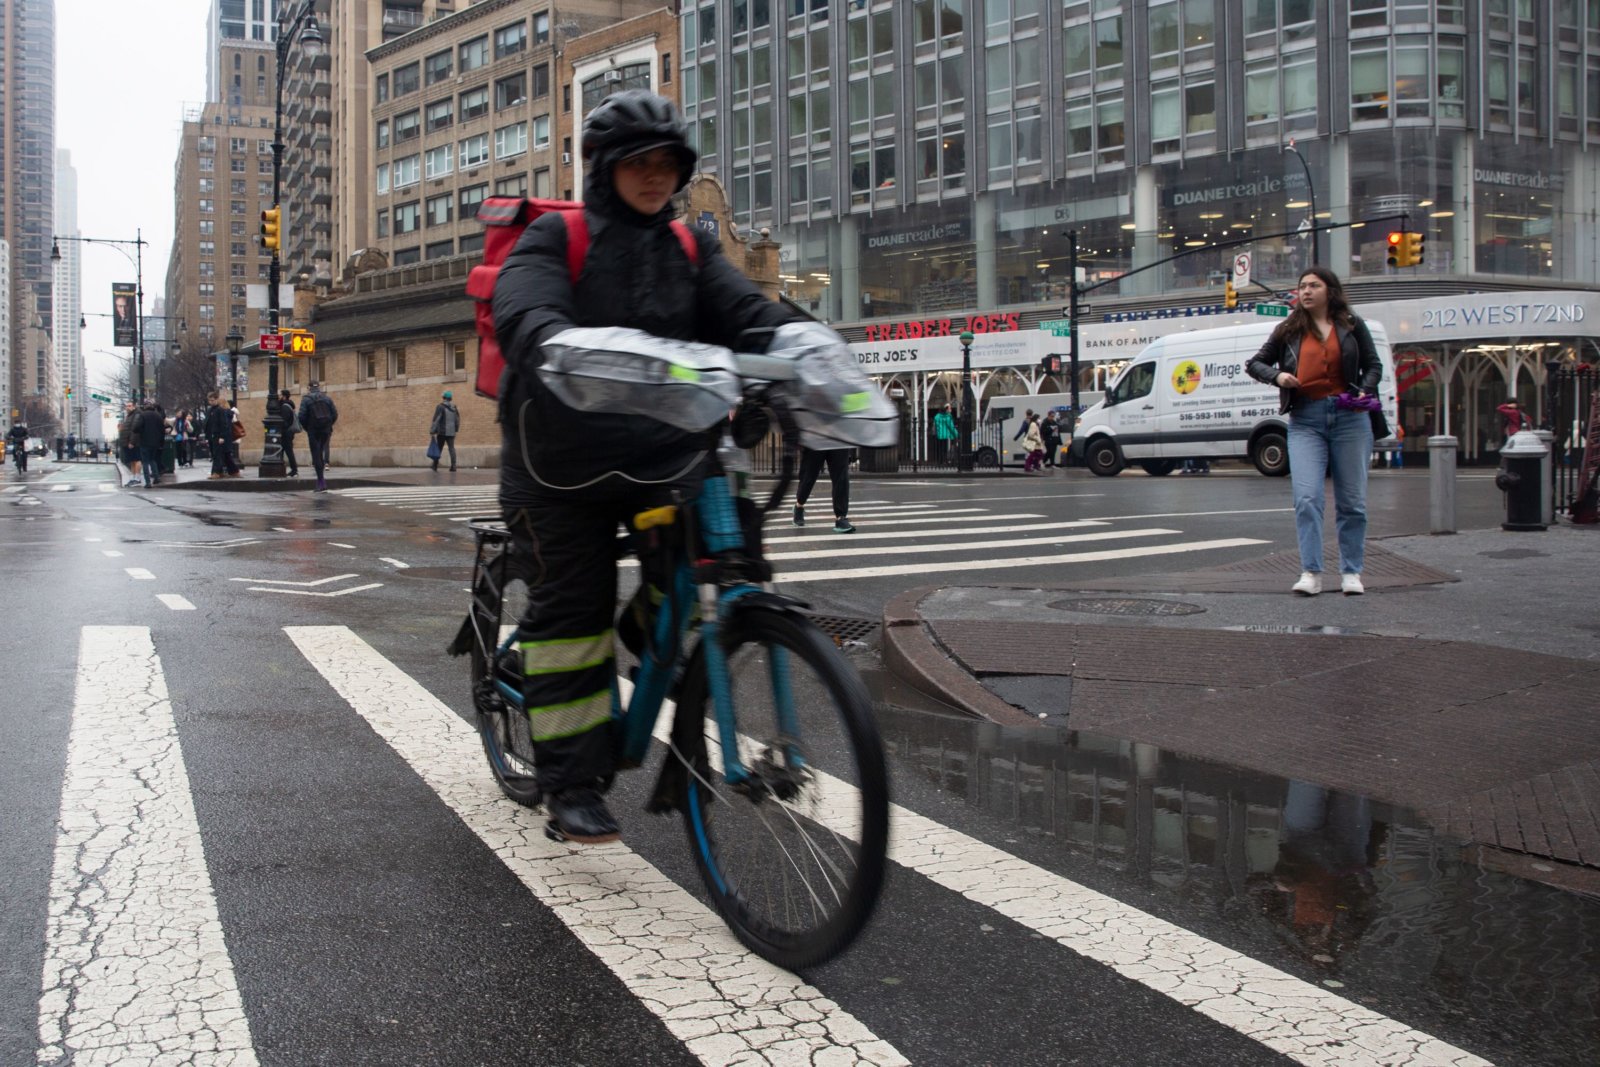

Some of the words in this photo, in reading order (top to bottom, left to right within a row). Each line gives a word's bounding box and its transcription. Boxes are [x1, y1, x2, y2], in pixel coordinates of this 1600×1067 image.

[1422, 308, 1456, 328] 212
[1461, 305, 1528, 325] WEST
[1533, 304, 1584, 323] 72ND
[865, 319, 951, 342] TRADER
[959, 313, 1020, 337] JOE'S
[302, 337, 314, 352] 20
[1086, 340, 1113, 348] BANK
[1116, 338, 1129, 346] OF
[852, 352, 880, 364] DER
[883, 349, 918, 362] JOE'S
[1204, 362, 1241, 379] Mirage
